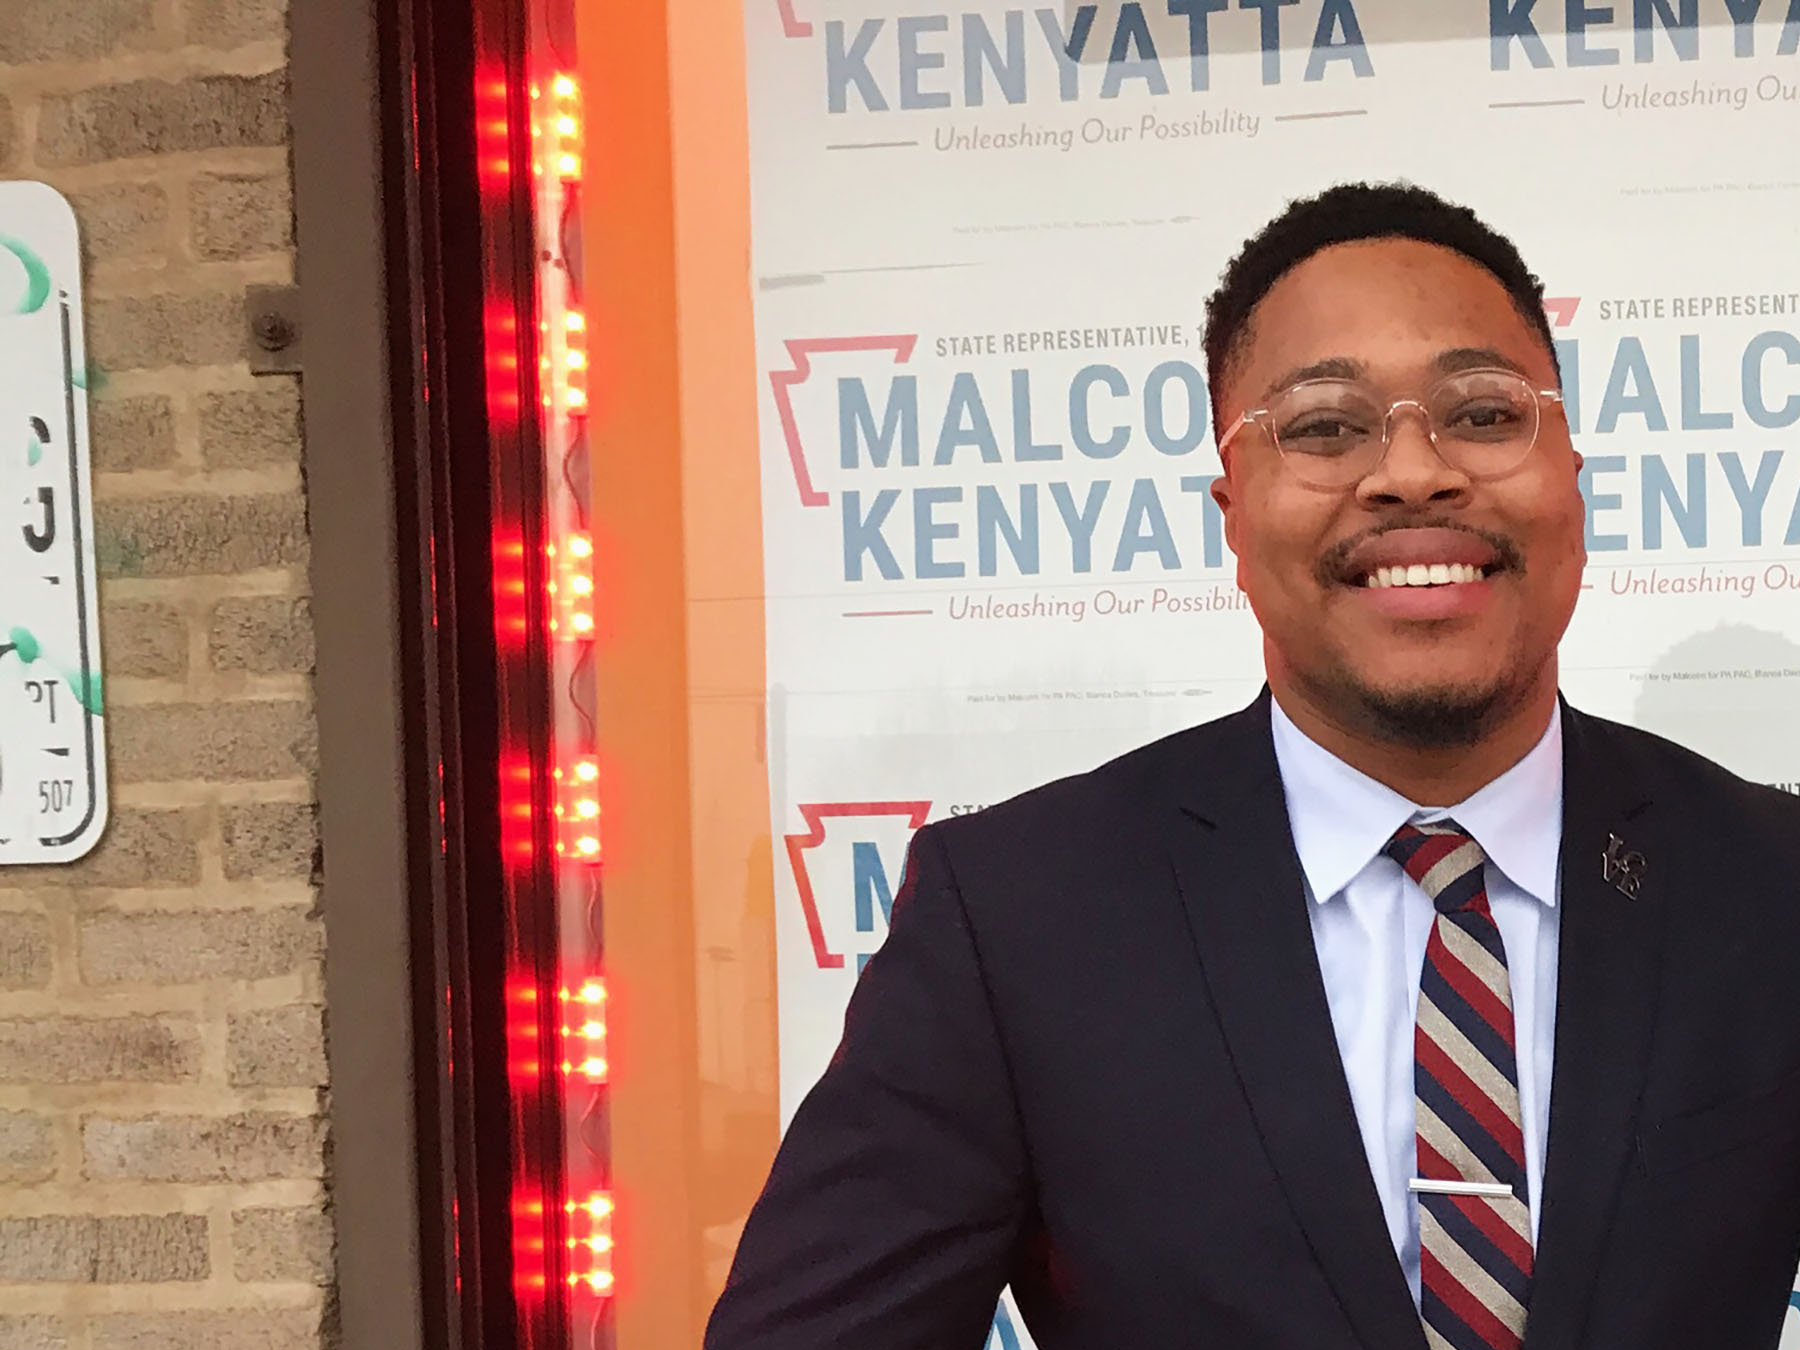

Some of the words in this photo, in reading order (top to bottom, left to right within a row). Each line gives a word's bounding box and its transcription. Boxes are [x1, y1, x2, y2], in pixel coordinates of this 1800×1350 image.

[826, 0, 1376, 114] KENYATTA
[1602, 81, 1748, 110] Unleashing
[933, 122, 1074, 153] Unleashing
[1080, 118, 1134, 146] Our
[1139, 110, 1261, 140] Possibility
[1600, 300, 1665, 320] STATE
[936, 335, 997, 358] STATE
[1003, 325, 1190, 354] REPRESENTATIVE,
[1610, 568, 1755, 598] Unleashing
[948, 594, 1086, 622] Unleashing
[1093, 590, 1144, 614] Our
[39, 780, 73, 814] 507
